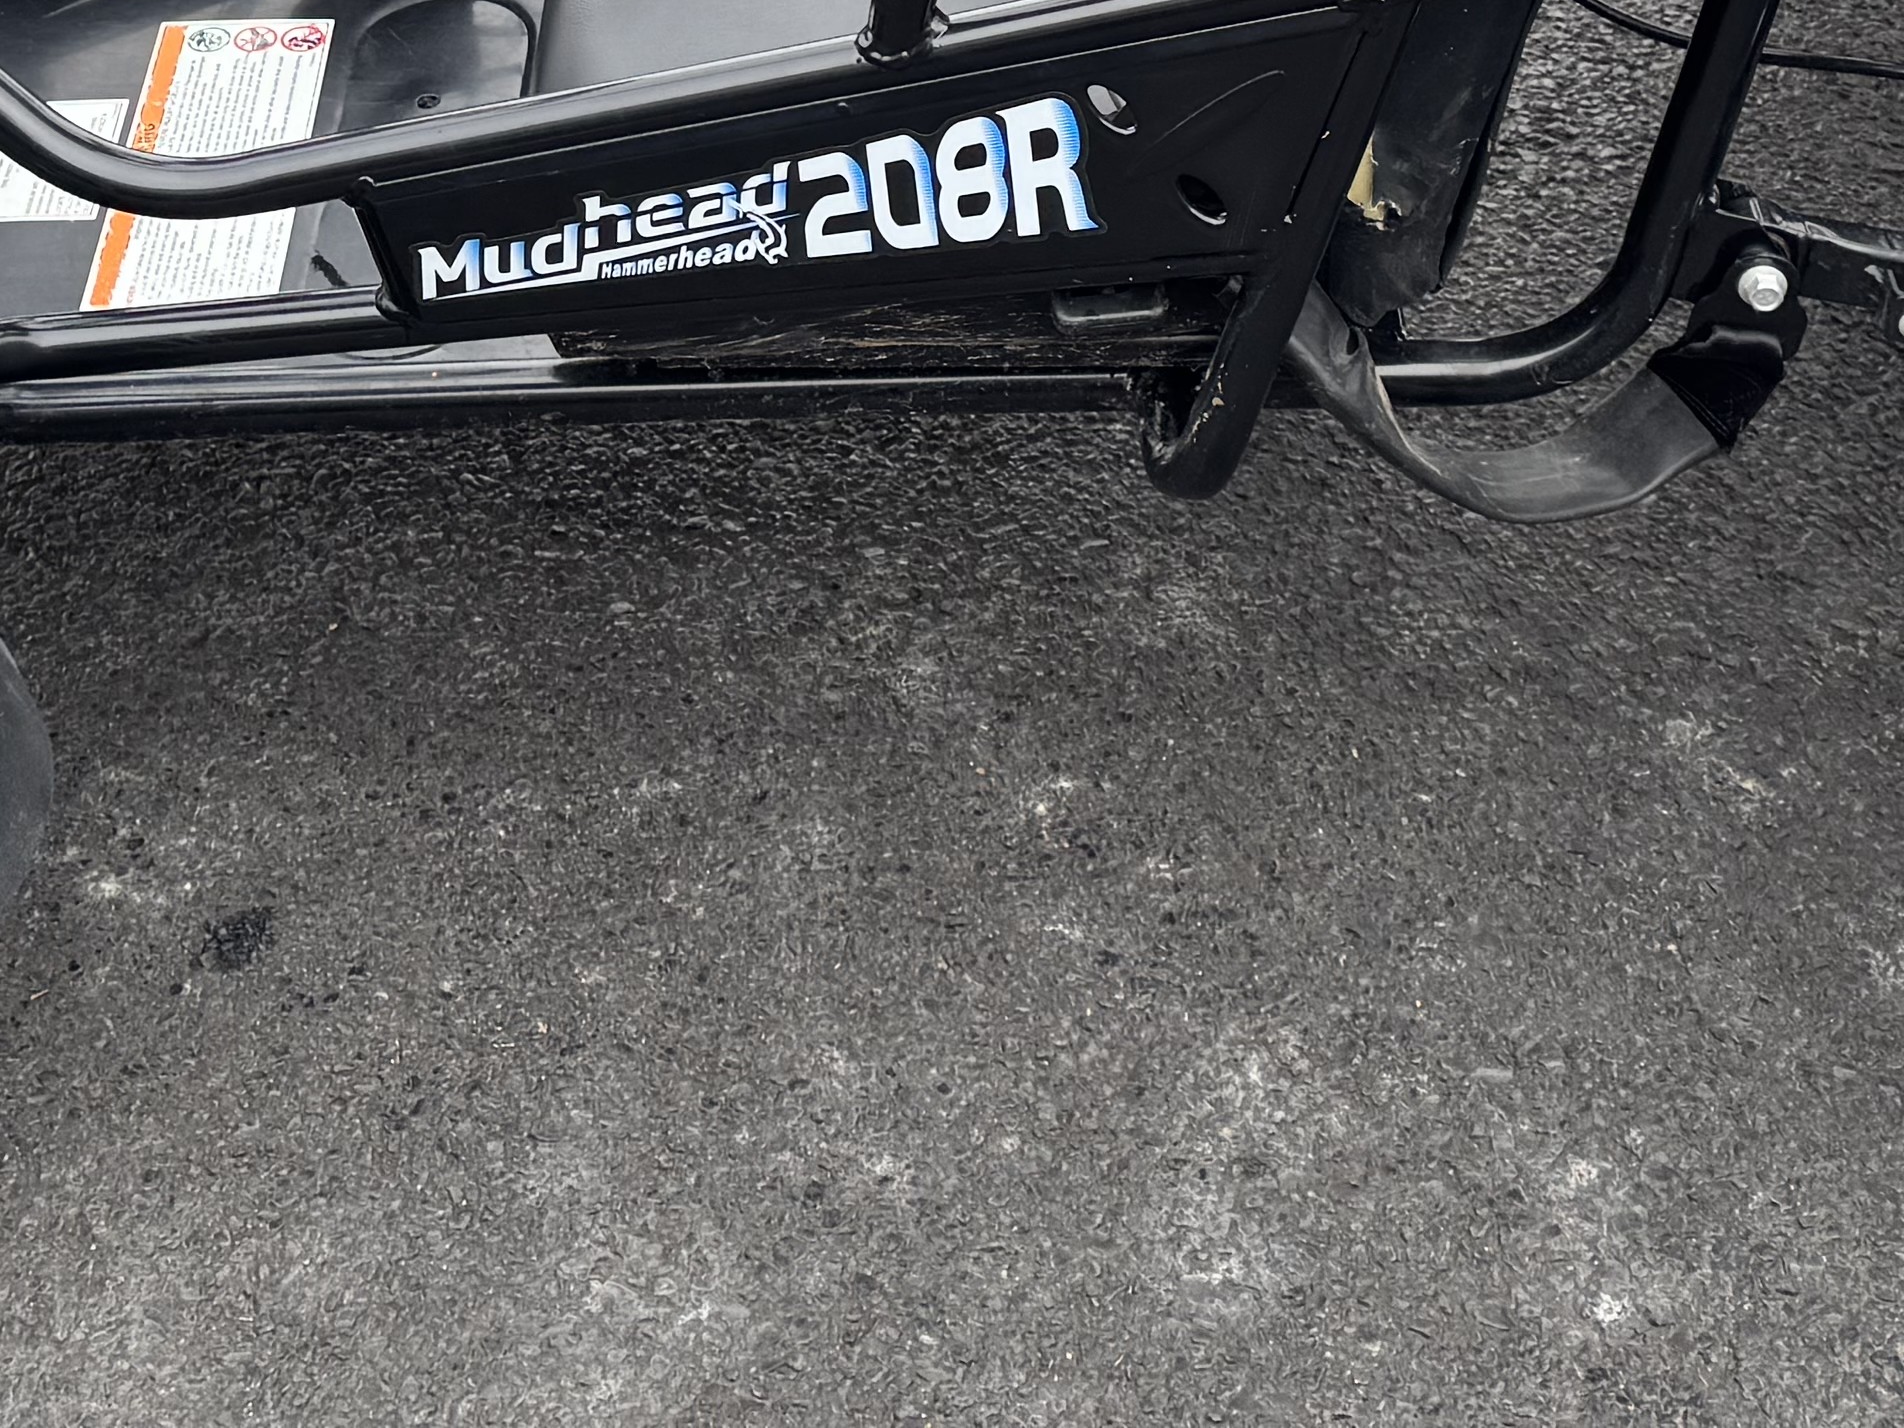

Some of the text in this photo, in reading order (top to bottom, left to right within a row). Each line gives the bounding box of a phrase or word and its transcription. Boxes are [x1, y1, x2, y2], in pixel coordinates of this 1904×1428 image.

[418, 161, 791, 300] Mudhead
[797, 97, 1098, 258] 208R
[600, 231, 760, 279] Hammerhead
